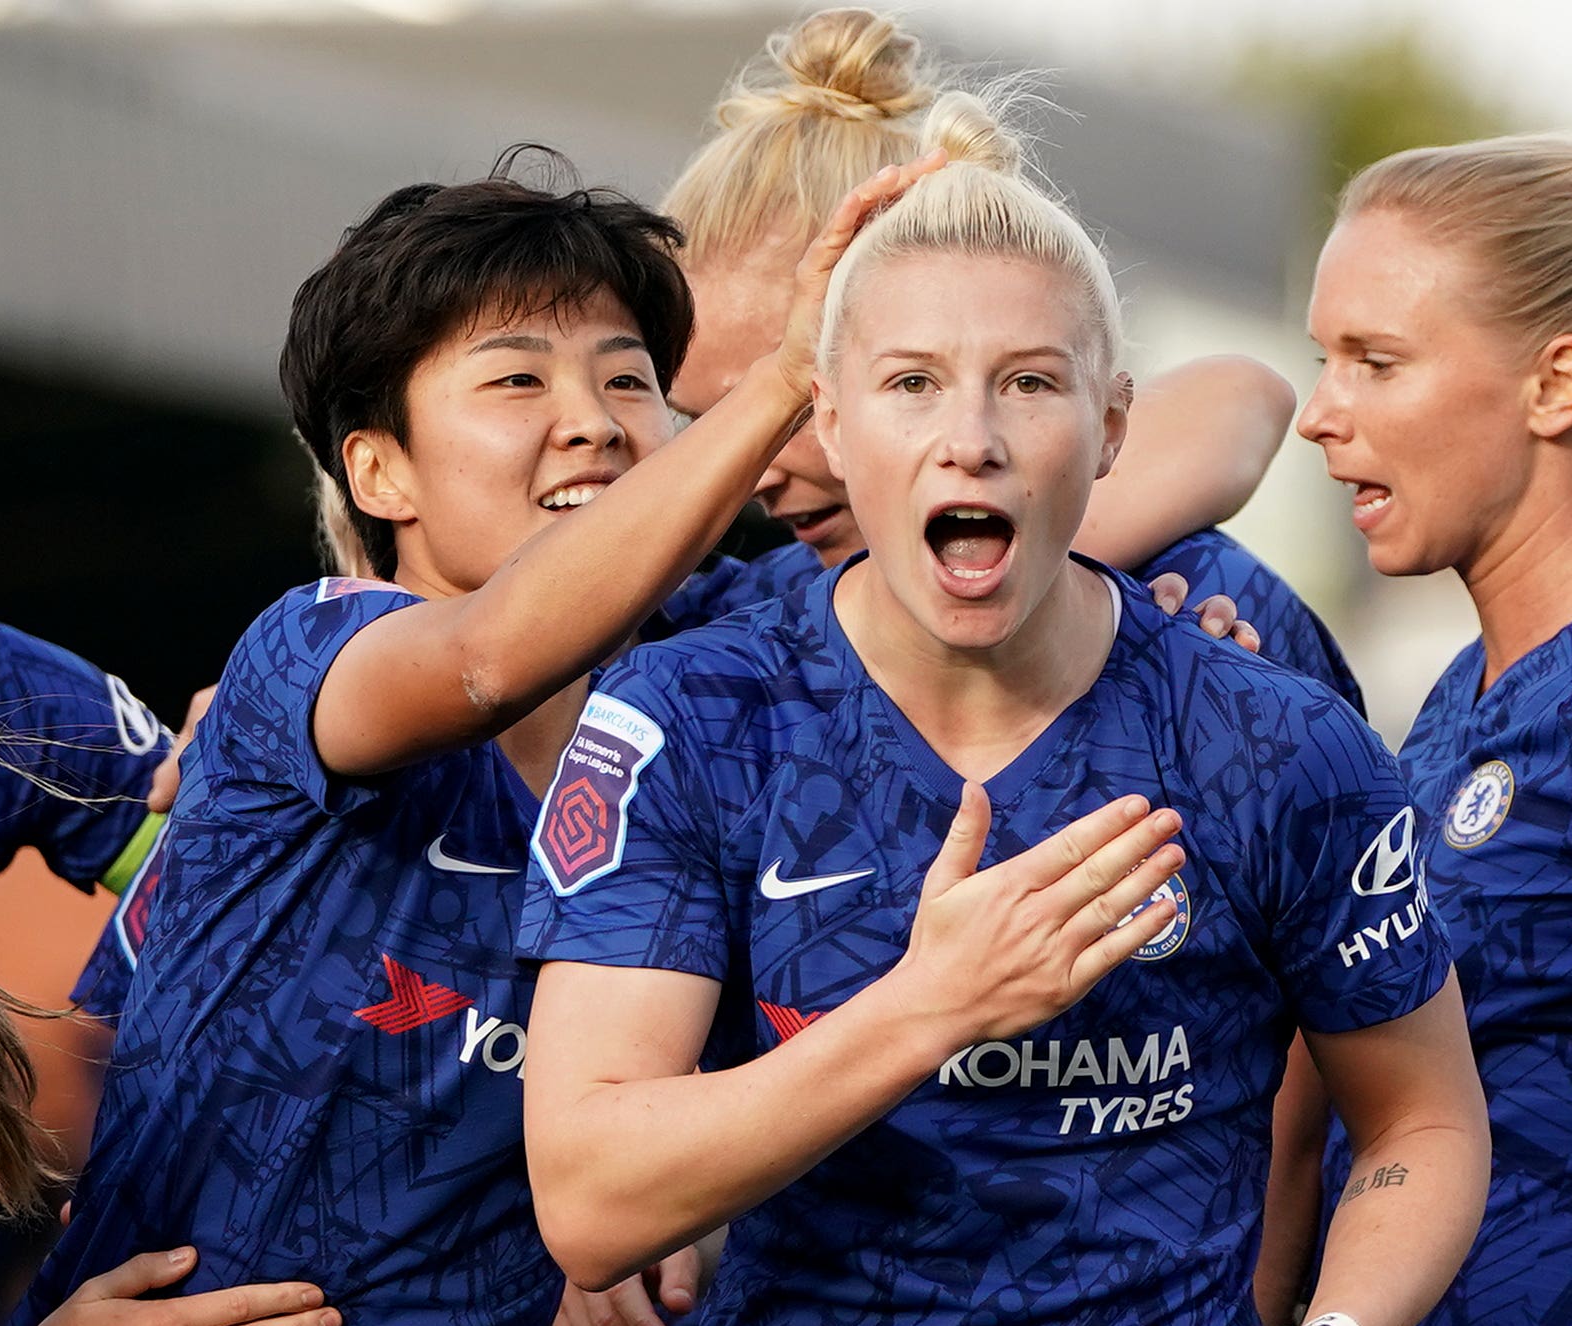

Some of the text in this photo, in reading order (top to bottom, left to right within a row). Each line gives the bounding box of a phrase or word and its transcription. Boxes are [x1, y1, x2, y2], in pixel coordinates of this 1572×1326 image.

[593, 705, 650, 742] BARCLAYS
[459, 1007, 527, 1079] YO
[939, 1025, 1191, 1088] KOHAMA
[1059, 1083, 1195, 1135] TYRES
